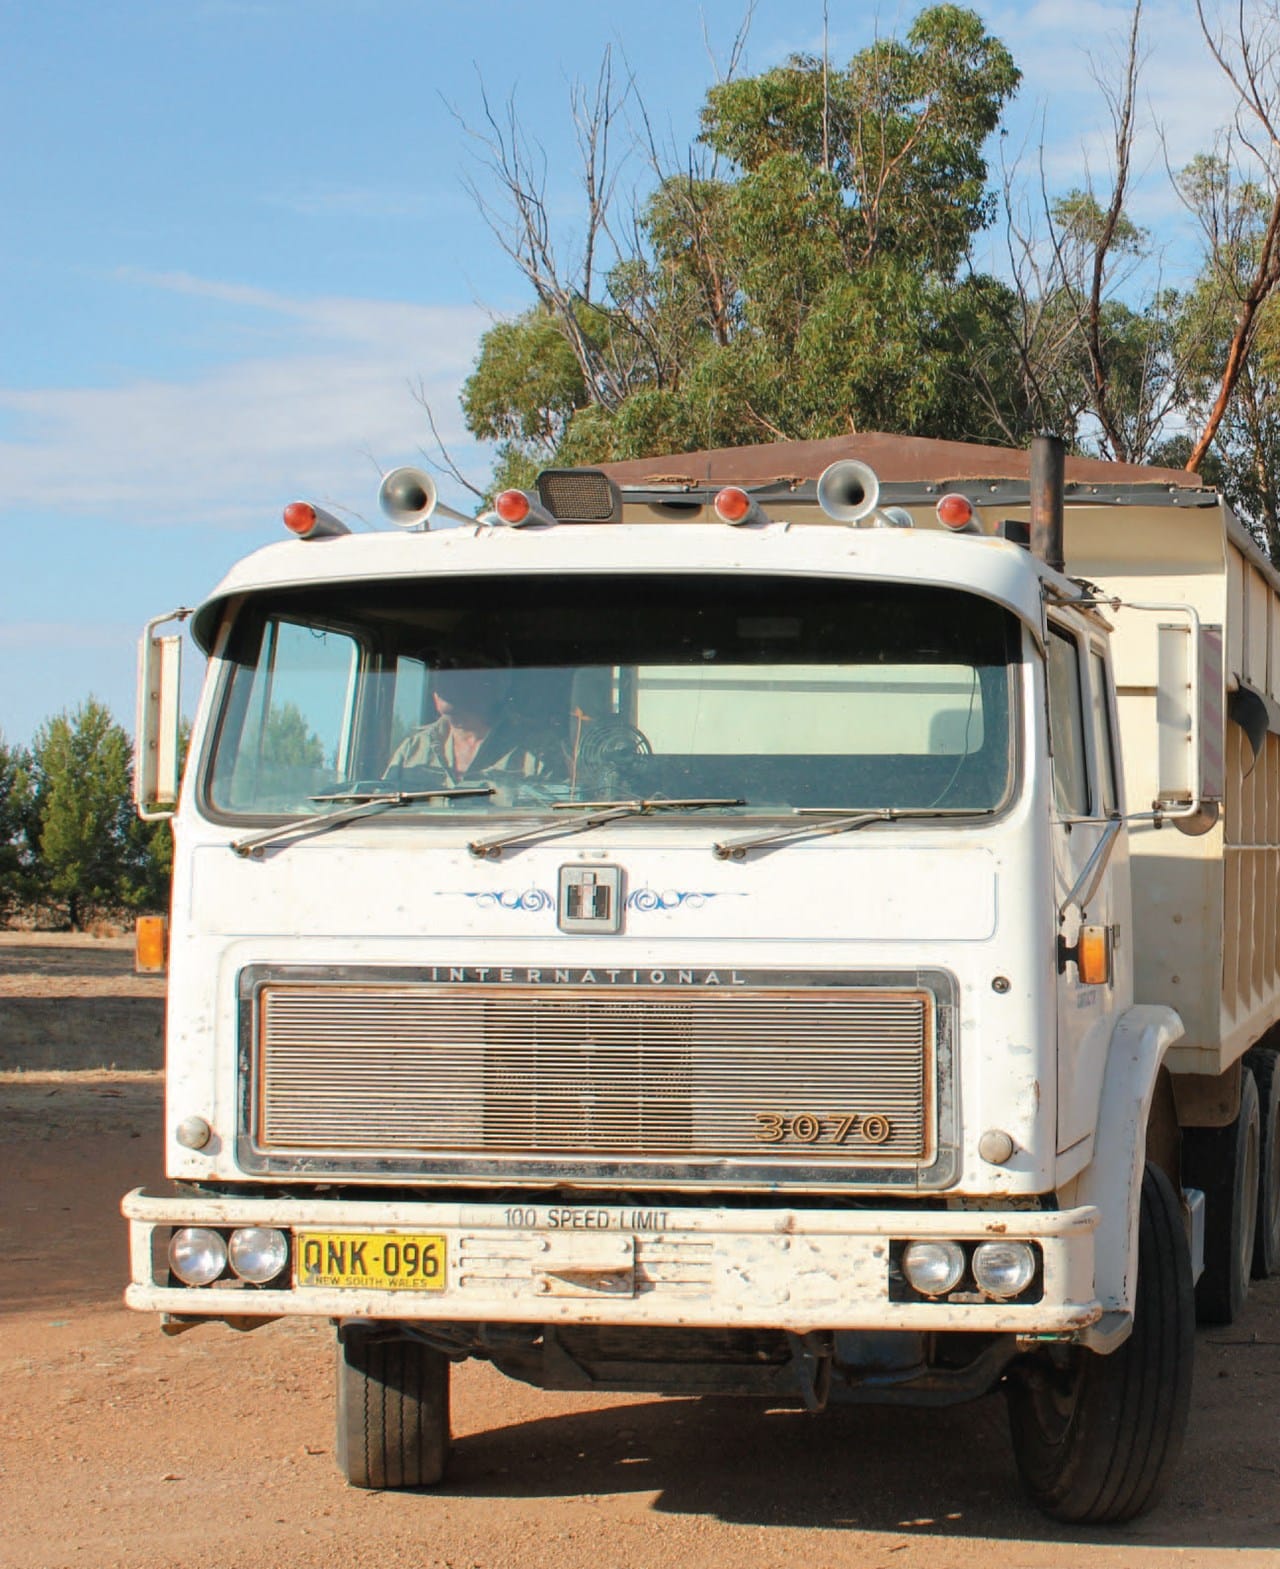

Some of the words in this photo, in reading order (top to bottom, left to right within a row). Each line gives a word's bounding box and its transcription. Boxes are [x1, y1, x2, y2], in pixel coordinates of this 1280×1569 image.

[432, 966, 745, 984] INTERNATIONAL
[755, 1112, 890, 1144] 3070
[504, 1208, 537, 1227] 100
[548, 1208, 609, 1229] SPEED
[620, 1211, 670, 1230] LIMIT
[315, 1276, 340, 1285] NEW
[346, 1277, 383, 1286] SOUTH
[389, 1278, 427, 1288] WALES
